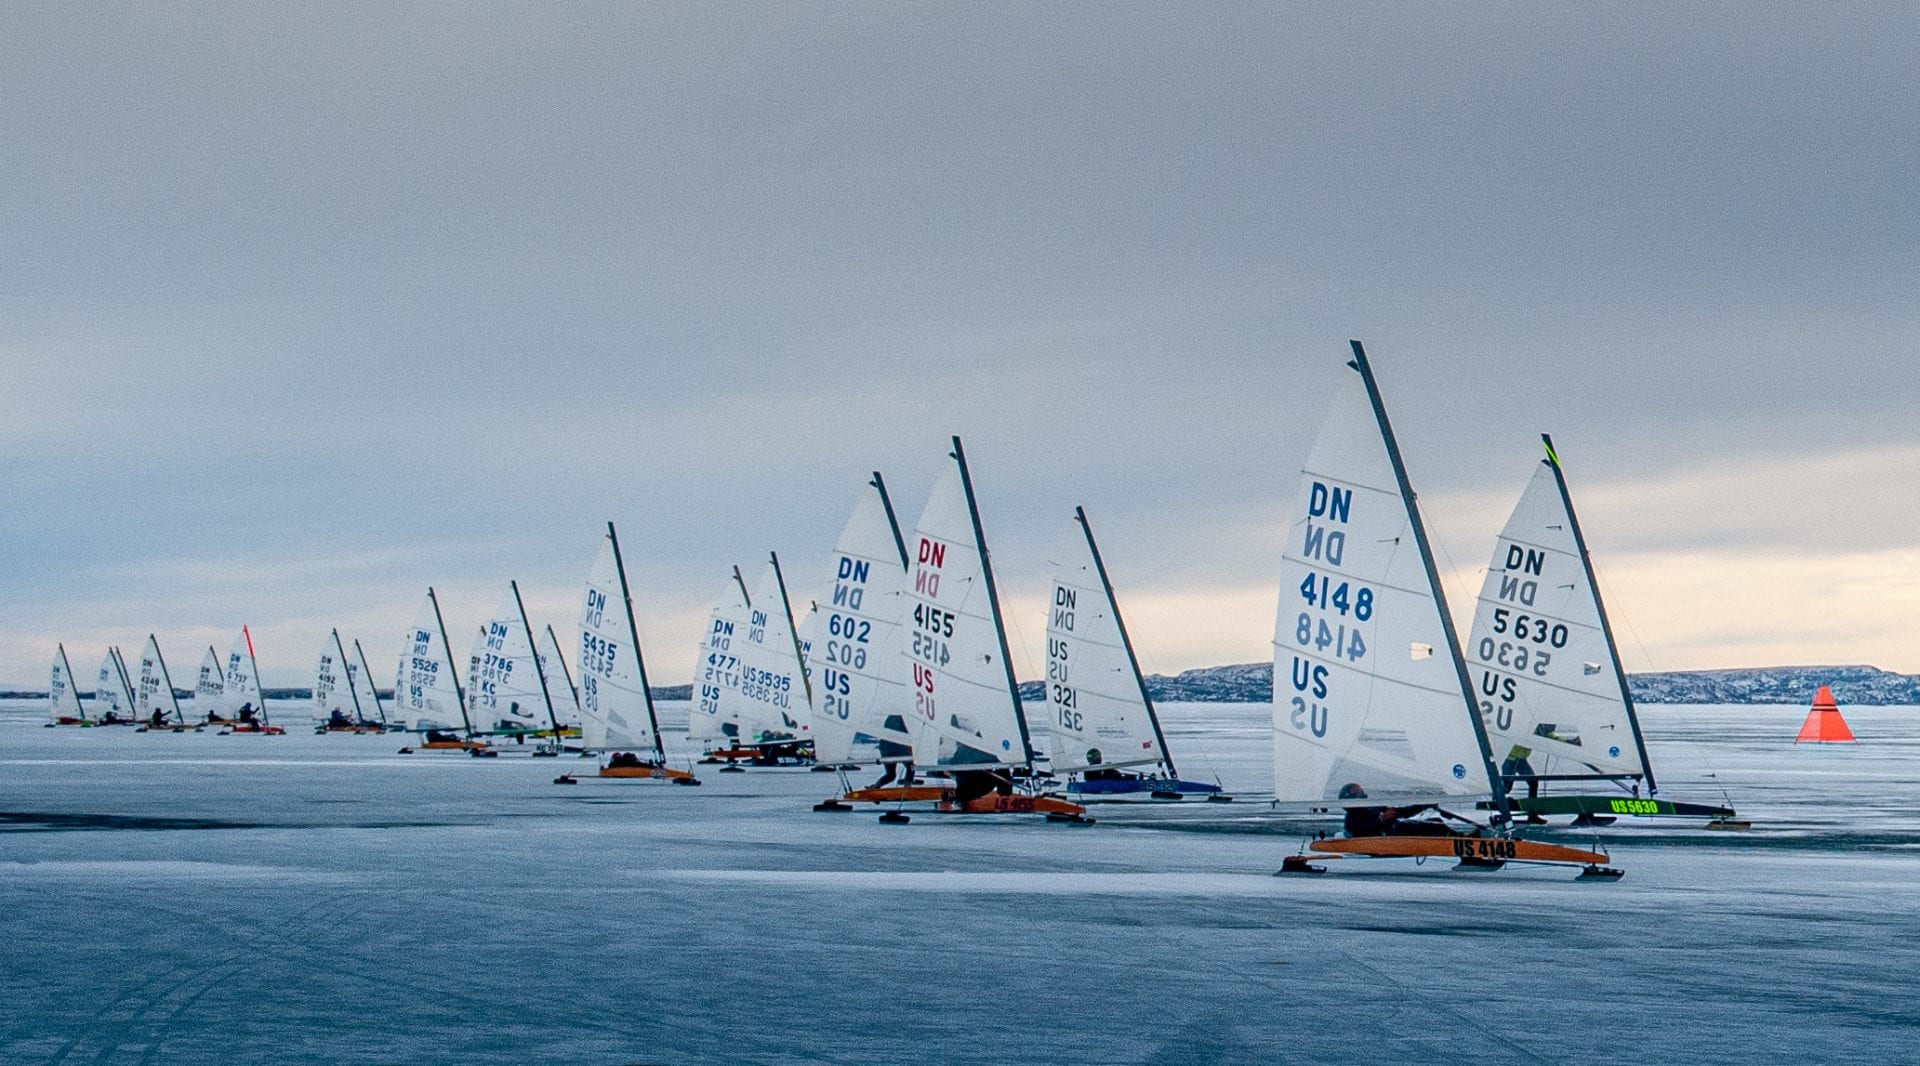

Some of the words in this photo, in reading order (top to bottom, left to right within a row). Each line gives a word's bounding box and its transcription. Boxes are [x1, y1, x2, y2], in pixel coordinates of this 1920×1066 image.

[1309, 481, 1352, 523] DN
[918, 538, 946, 569] DN
[1505, 544, 1545, 576] DN
[838, 556, 870, 584] DN
[588, 589, 606, 611] DN
[1056, 586, 1076, 609] DN
[1300, 572, 1373, 621] 4148
[490, 622, 508, 638] DN
[714, 620, 734, 636] DN
[751, 610, 767, 627] DN
[829, 614, 871, 643] 602
[913, 603, 955, 638] 4155
[1493, 608, 1568, 648] 5630
[416, 631, 431, 643] DN
[583, 631, 617, 661] 5435
[1049, 638, 1068, 660] US
[411, 658, 439, 673] 5526
[484, 653, 513, 672] 3786
[708, 653, 741, 671] 477
[482, 680, 496, 695] KC
[584, 673, 597, 695] US
[824, 668, 850, 696] US
[913, 663, 933, 693] US
[1292, 656, 1329, 699] US
[1482, 671, 1516, 702] US
[410, 686, 423, 697] US
[702, 684, 720, 700] US
[1053, 684, 1077, 709] 321
[1454, 839, 1475, 858] US
[1479, 840, 1516, 859] 4148
